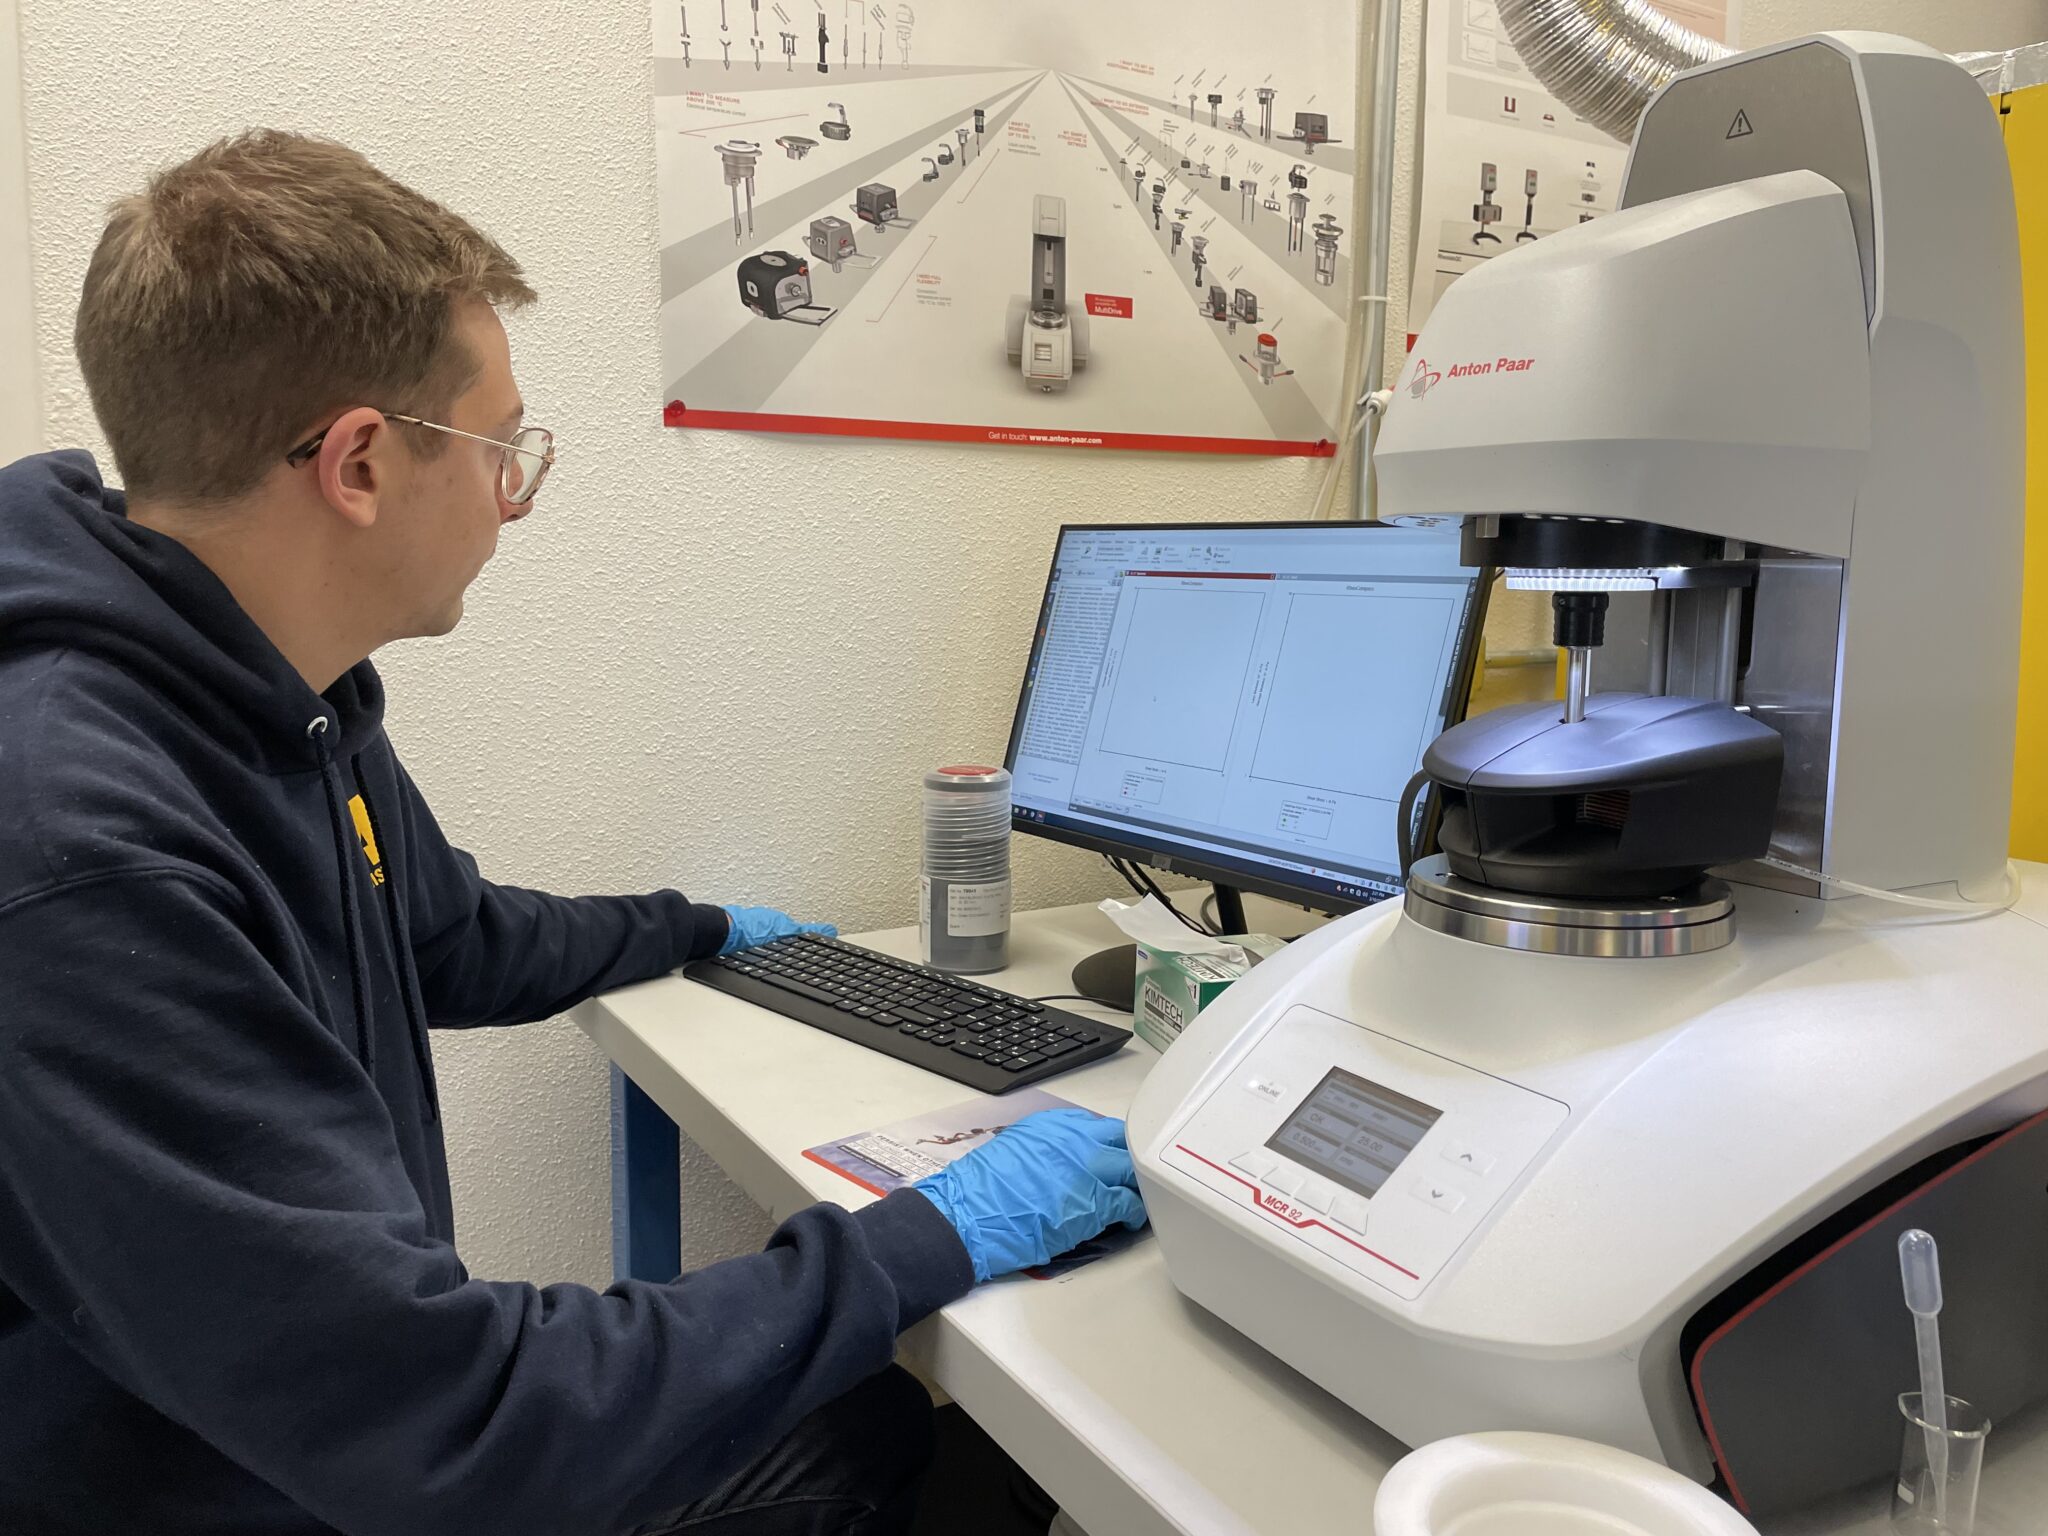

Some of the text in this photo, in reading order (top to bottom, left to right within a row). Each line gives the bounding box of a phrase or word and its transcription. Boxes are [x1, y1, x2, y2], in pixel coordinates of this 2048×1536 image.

[1094, 305, 1122, 315] MultiDrive
[1447, 357, 1535, 378] Anton Paar
[988, 431, 1001, 440] Get
[1029, 434, 1102, 444] www.anton-paar.com
[1144, 986, 1183, 1024] KIMTECH
[1264, 1195, 1303, 1221] MCR 92
